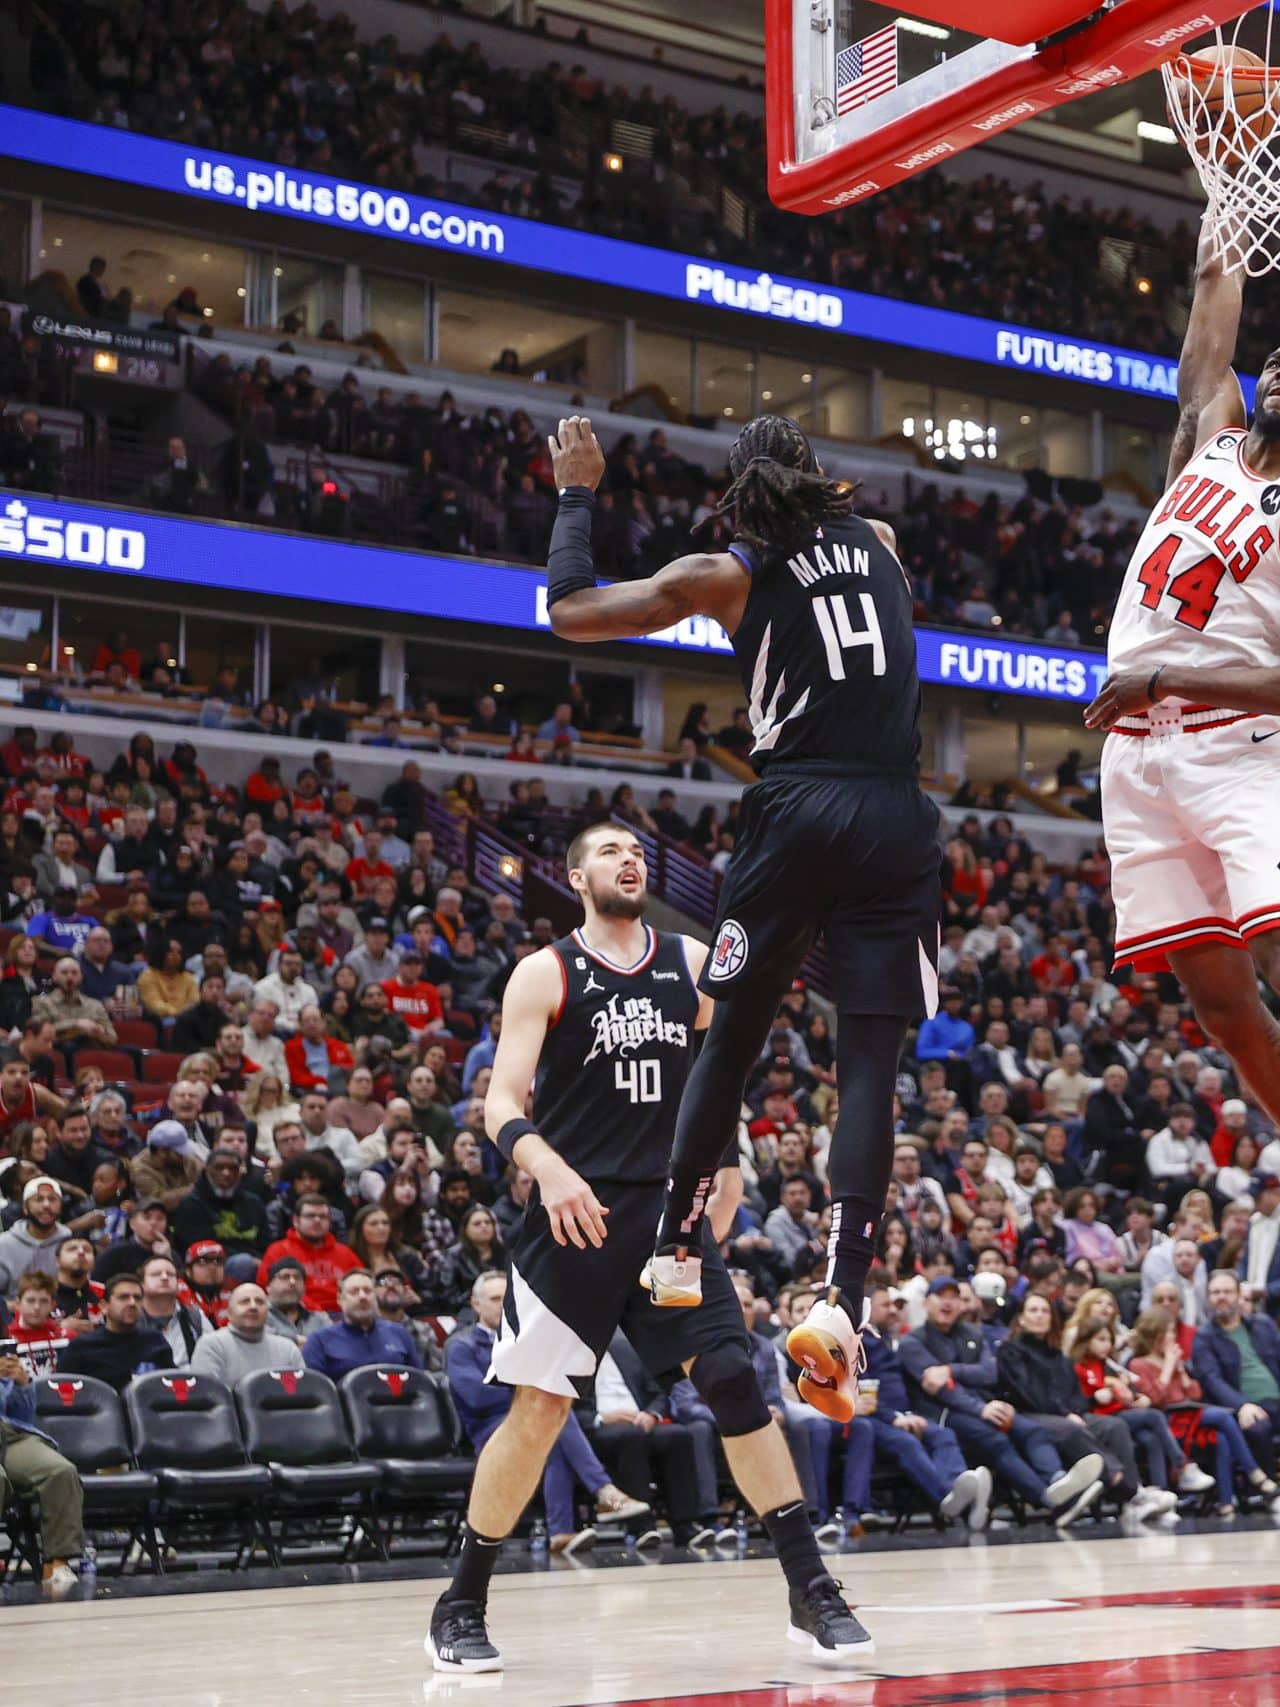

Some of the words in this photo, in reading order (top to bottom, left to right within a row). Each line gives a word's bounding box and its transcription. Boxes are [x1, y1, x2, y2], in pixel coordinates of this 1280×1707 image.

[1145, 14, 1215, 48] betway
[1056, 65, 1123, 95] betway
[972, 101, 1035, 131] betway
[895, 142, 955, 170] betway
[185, 158, 505, 254] us.plus500.com
[822, 180, 880, 206] betway
[686, 264, 843, 328] Plus500
[996, 330, 1112, 382] FUTURES
[1153, 474, 1275, 584] BULLS
[786, 543, 869, 588] MANN
[1137, 533, 1227, 632] 44
[812, 593, 887, 681] 14
[940, 643, 1087, 697] FUTURES
[606, 993, 655, 1022] Los
[583, 1008, 688, 1067] Angeles
[615, 1059, 662, 1103] 40
